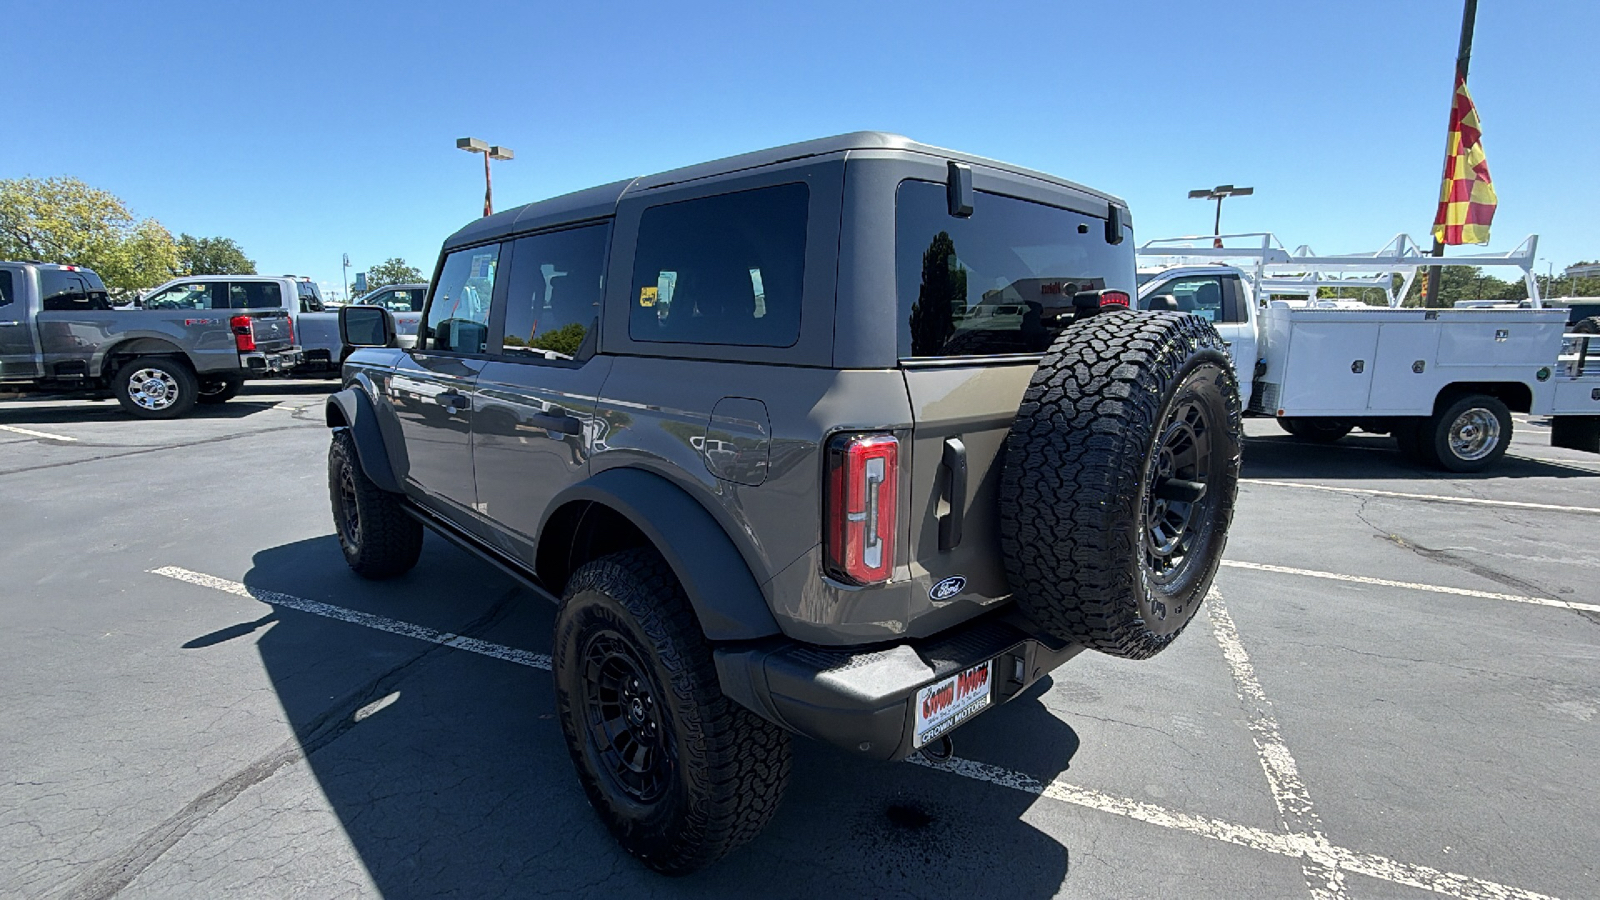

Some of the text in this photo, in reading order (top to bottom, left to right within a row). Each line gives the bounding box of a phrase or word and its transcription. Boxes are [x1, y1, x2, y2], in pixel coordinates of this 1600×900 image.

[184, 318, 219, 327] FX4
[937, 579, 961, 598] Ford
[922, 682, 954, 720] Crown
[957, 663, 988, 701] Motors
[922, 717, 953, 742] CROWN
[954, 696, 987, 723] MOTORS
